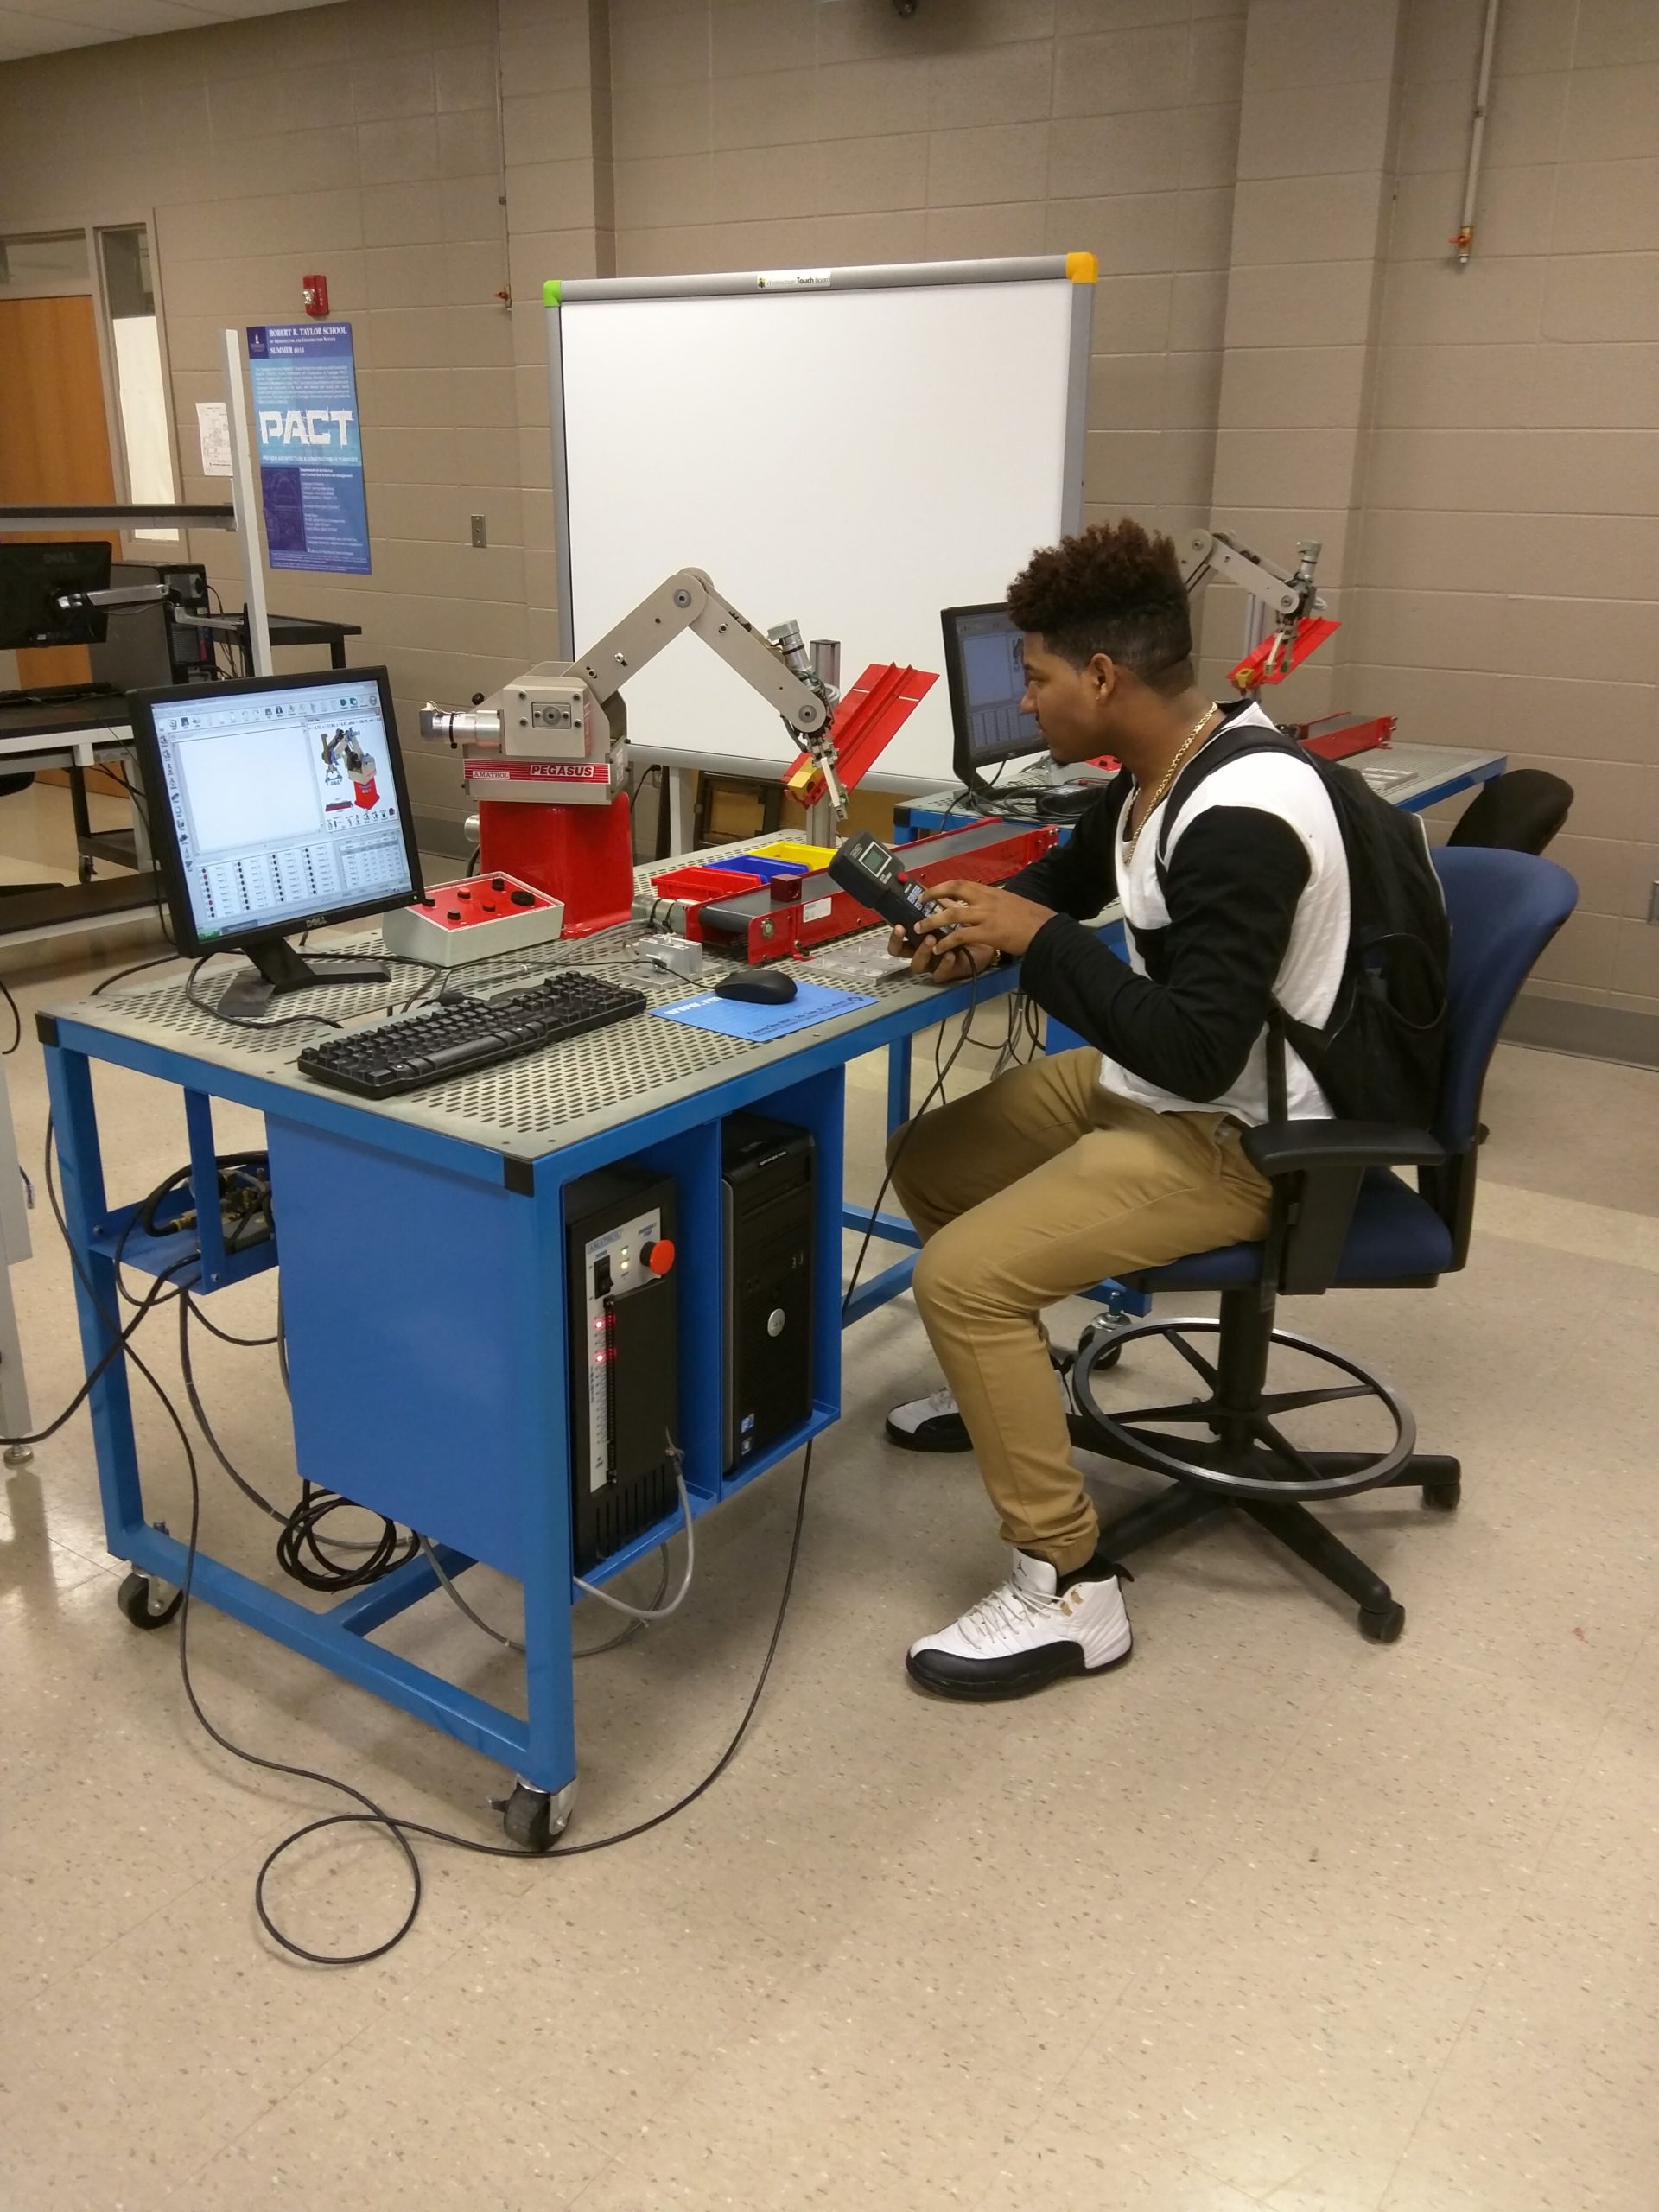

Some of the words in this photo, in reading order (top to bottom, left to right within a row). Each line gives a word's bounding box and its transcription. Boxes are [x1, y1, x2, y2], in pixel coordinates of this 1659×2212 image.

[797, 276, 814, 284] Touch
[269, 328, 292, 337] ROBERT
[300, 327, 322, 336] TAYLOR
[259, 409, 354, 447] PACT
[531, 765, 593, 777] PEGASUS
[305, 916, 327, 929] DELL
